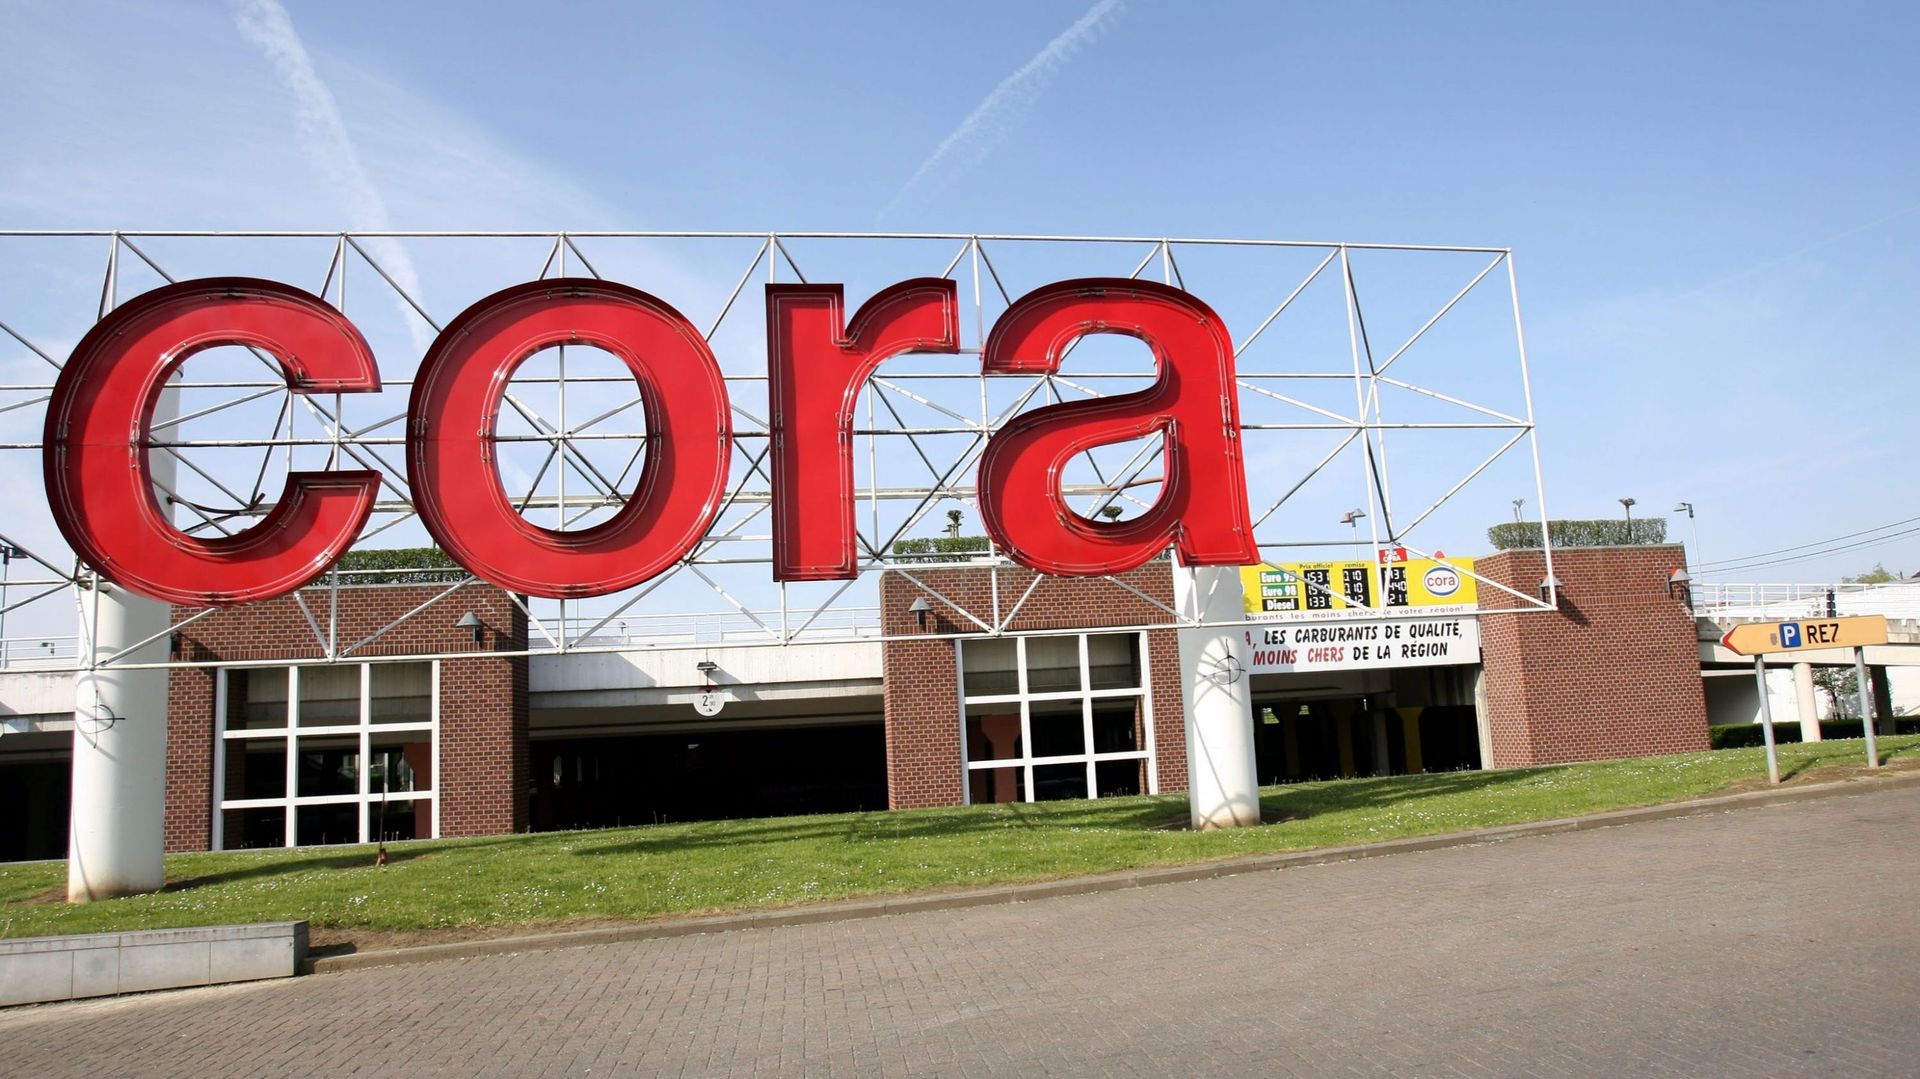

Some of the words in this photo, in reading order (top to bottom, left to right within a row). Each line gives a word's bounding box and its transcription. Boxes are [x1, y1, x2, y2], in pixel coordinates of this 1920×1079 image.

[43, 276, 1260, 605] cora
[1261, 573, 1282, 583] Euro
[1427, 576, 1456, 587] cora
[1262, 586, 1283, 597] Euro
[1285, 585, 1297, 596] 98
[1267, 599, 1295, 610] Diesel
[1399, 607, 1423, 615] votre
[1264, 630, 1287, 645] LES
[1295, 625, 1378, 643] CARBURANTS
[1385, 625, 1401, 639] DE
[1409, 618, 1463, 639] QUALITÉ,
[1783, 625, 1796, 645] P
[1253, 649, 1298, 666] MOINS
[1308, 647, 1344, 663] CHERS
[1353, 646, 1369, 661] DE
[1377, 645, 1391, 659] LA
[1402, 640, 1448, 659] RÉGION
